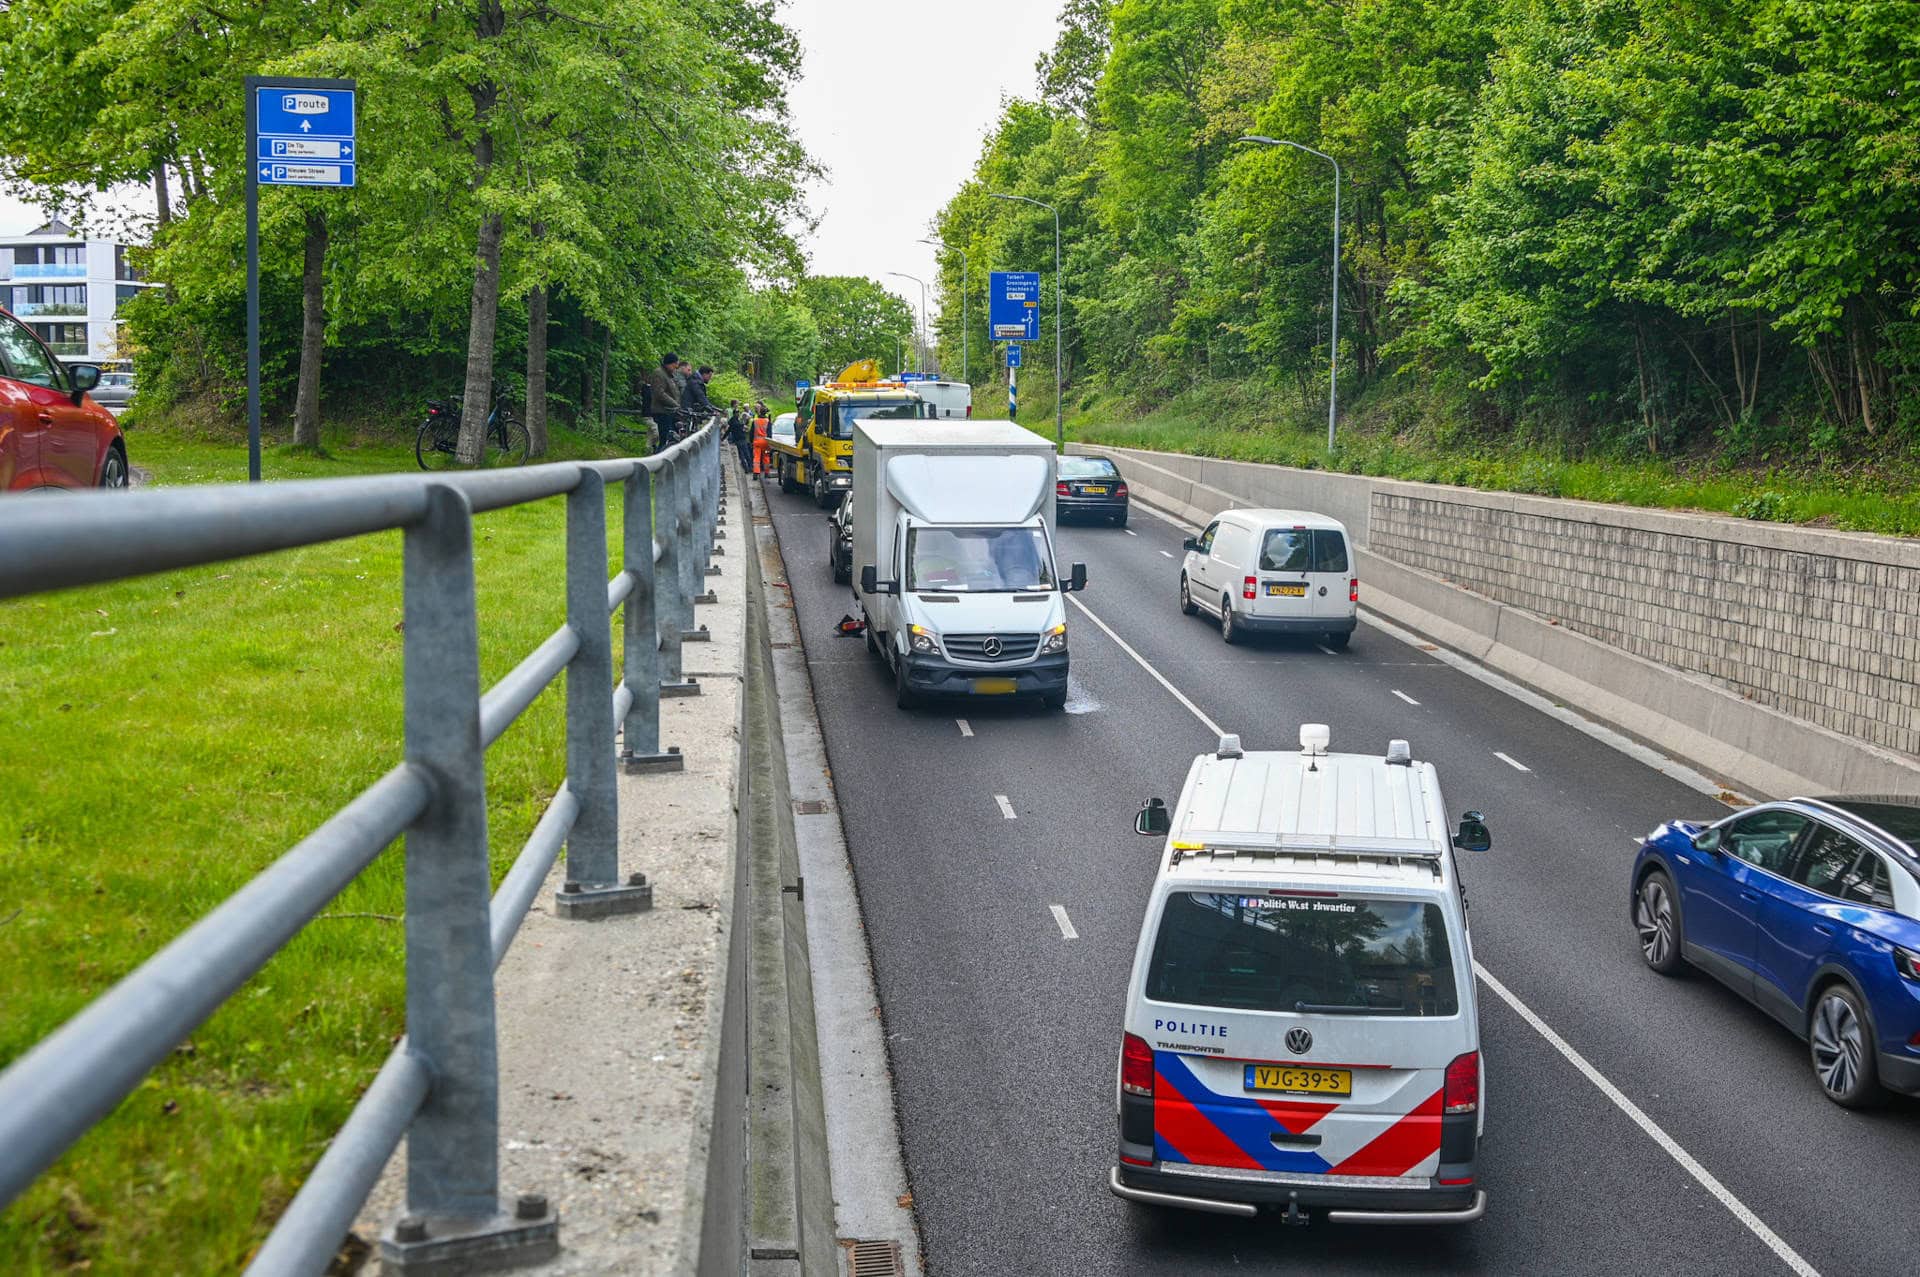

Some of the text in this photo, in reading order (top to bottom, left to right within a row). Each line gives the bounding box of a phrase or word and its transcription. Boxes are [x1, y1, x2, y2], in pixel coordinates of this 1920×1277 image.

[298, 100, 326, 109] route
[1258, 898, 1287, 910] Politie
[1155, 1019, 1228, 1037] POLITIE
[1156, 1041, 1225, 1054] TRANSPORTER
[1259, 1068, 1340, 1090] VJG-39-S
